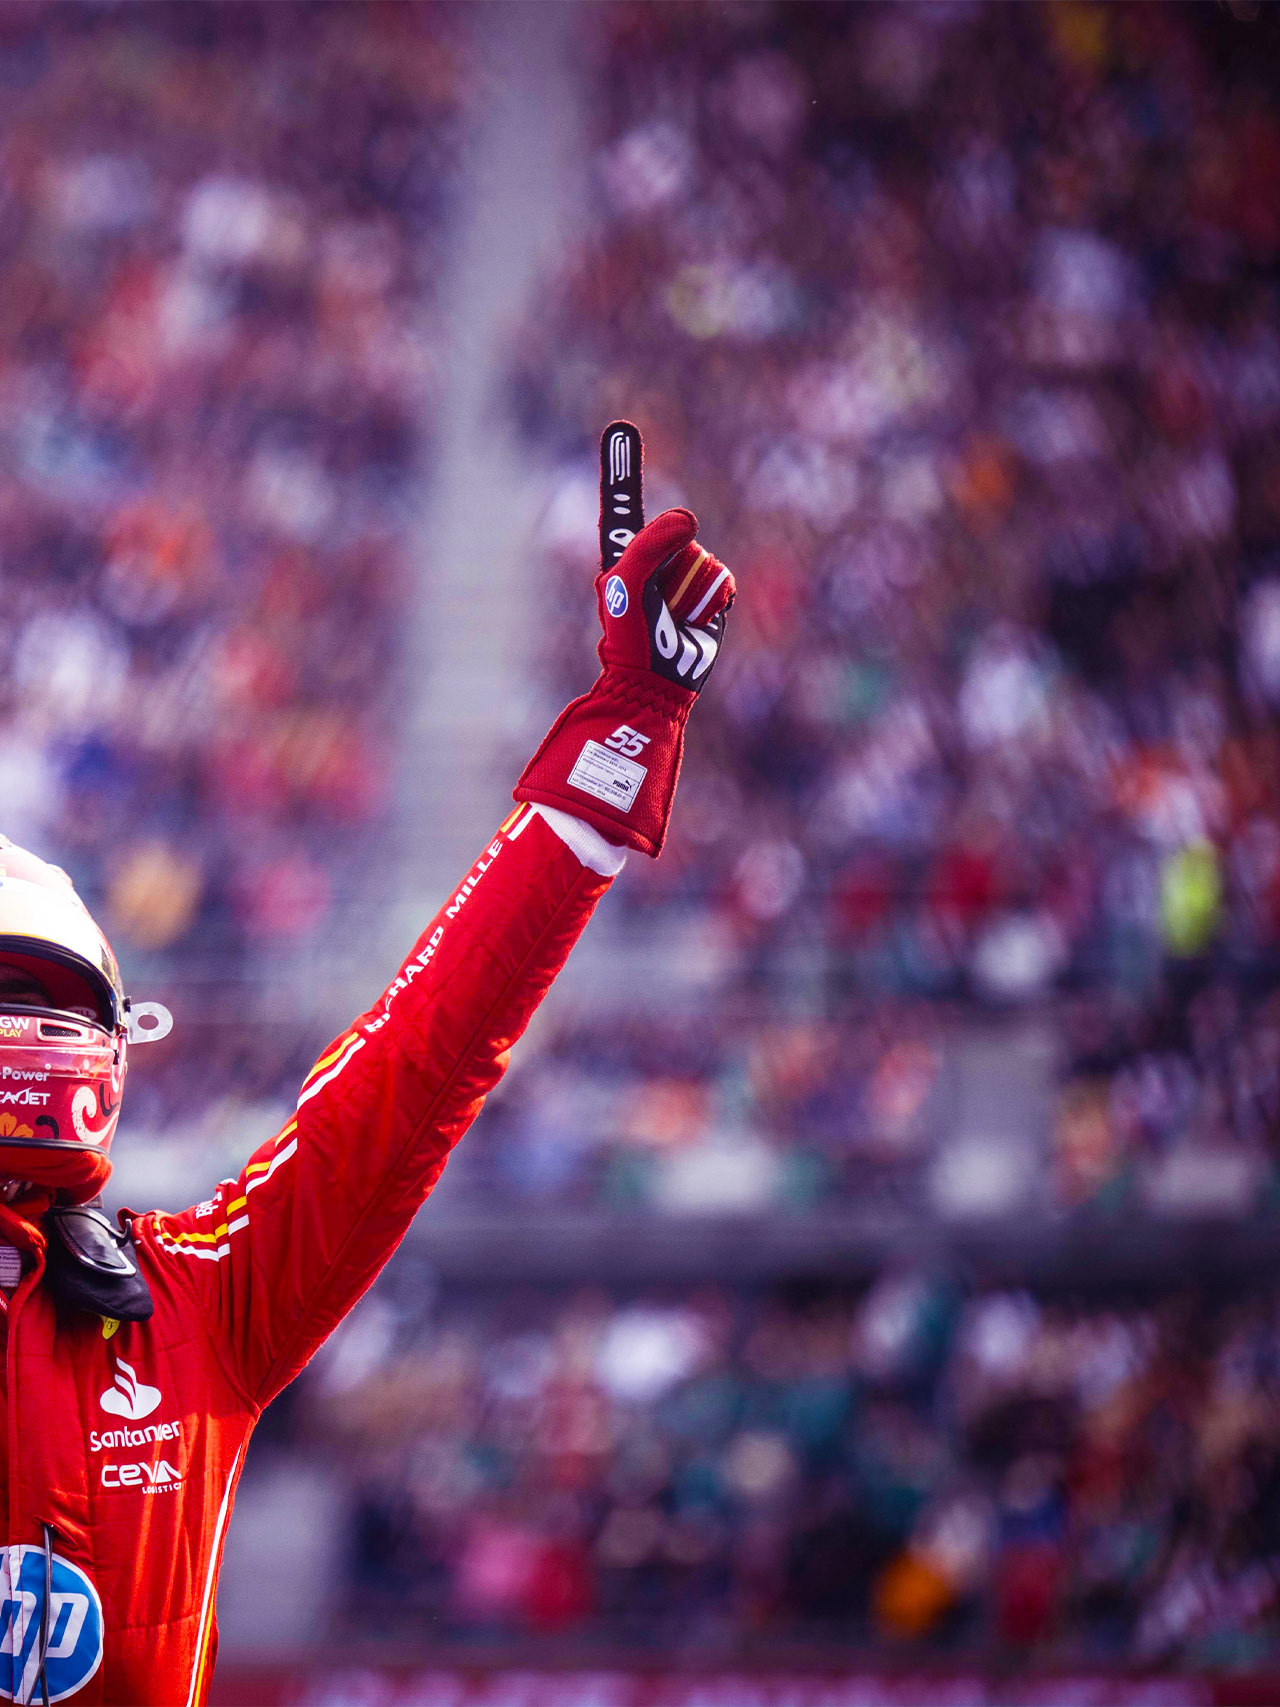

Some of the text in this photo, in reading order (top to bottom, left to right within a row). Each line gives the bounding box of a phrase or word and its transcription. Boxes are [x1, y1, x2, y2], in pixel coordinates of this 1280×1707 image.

[606, 577, 627, 616] hp
[604, 724, 652, 757] 55
[445, 839, 504, 920] MILLE
